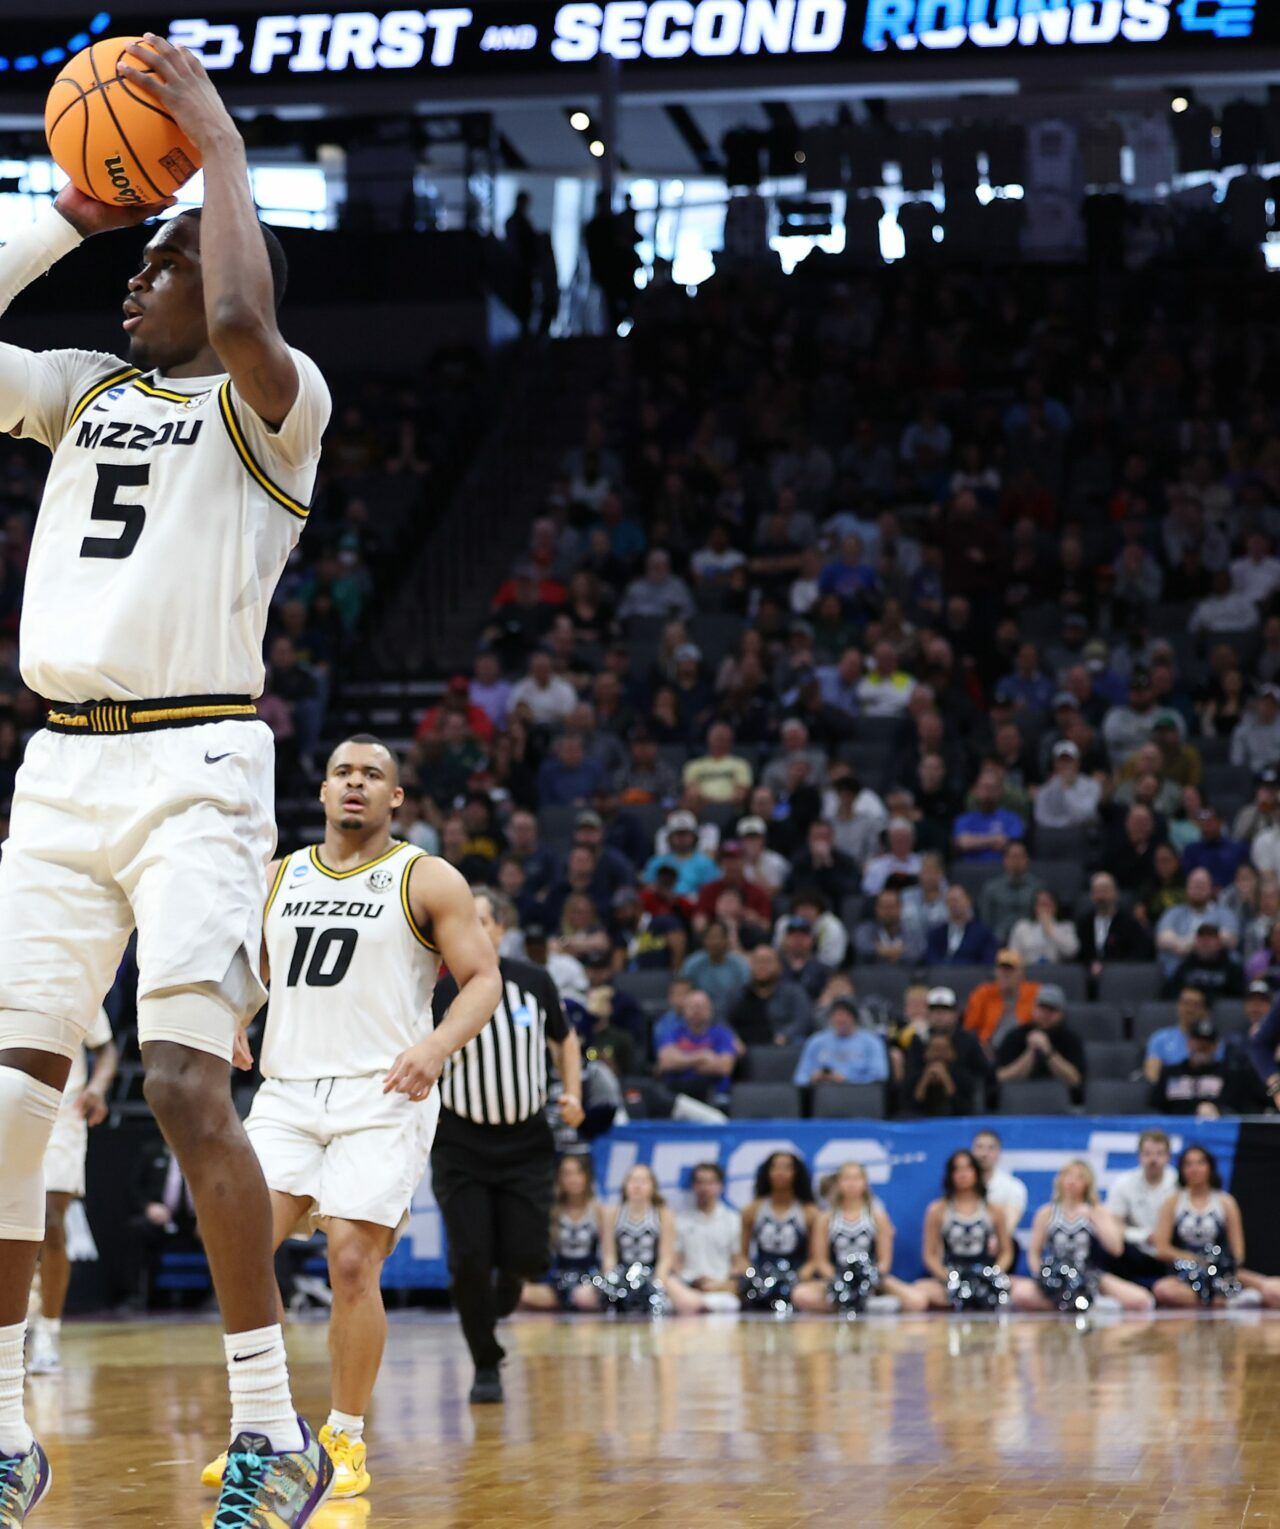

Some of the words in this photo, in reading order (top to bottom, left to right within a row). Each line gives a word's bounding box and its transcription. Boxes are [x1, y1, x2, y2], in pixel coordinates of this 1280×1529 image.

[250, 8, 473, 73] FIRST
[480, 24, 537, 51] AND
[551, 0, 847, 62] SECOND
[862, 0, 1171, 51] ROUNDS
[75, 420, 203, 451] MZZOU
[79, 463, 151, 560] 5
[281, 900, 384, 919] MIZZOU
[287, 926, 359, 987] 10
